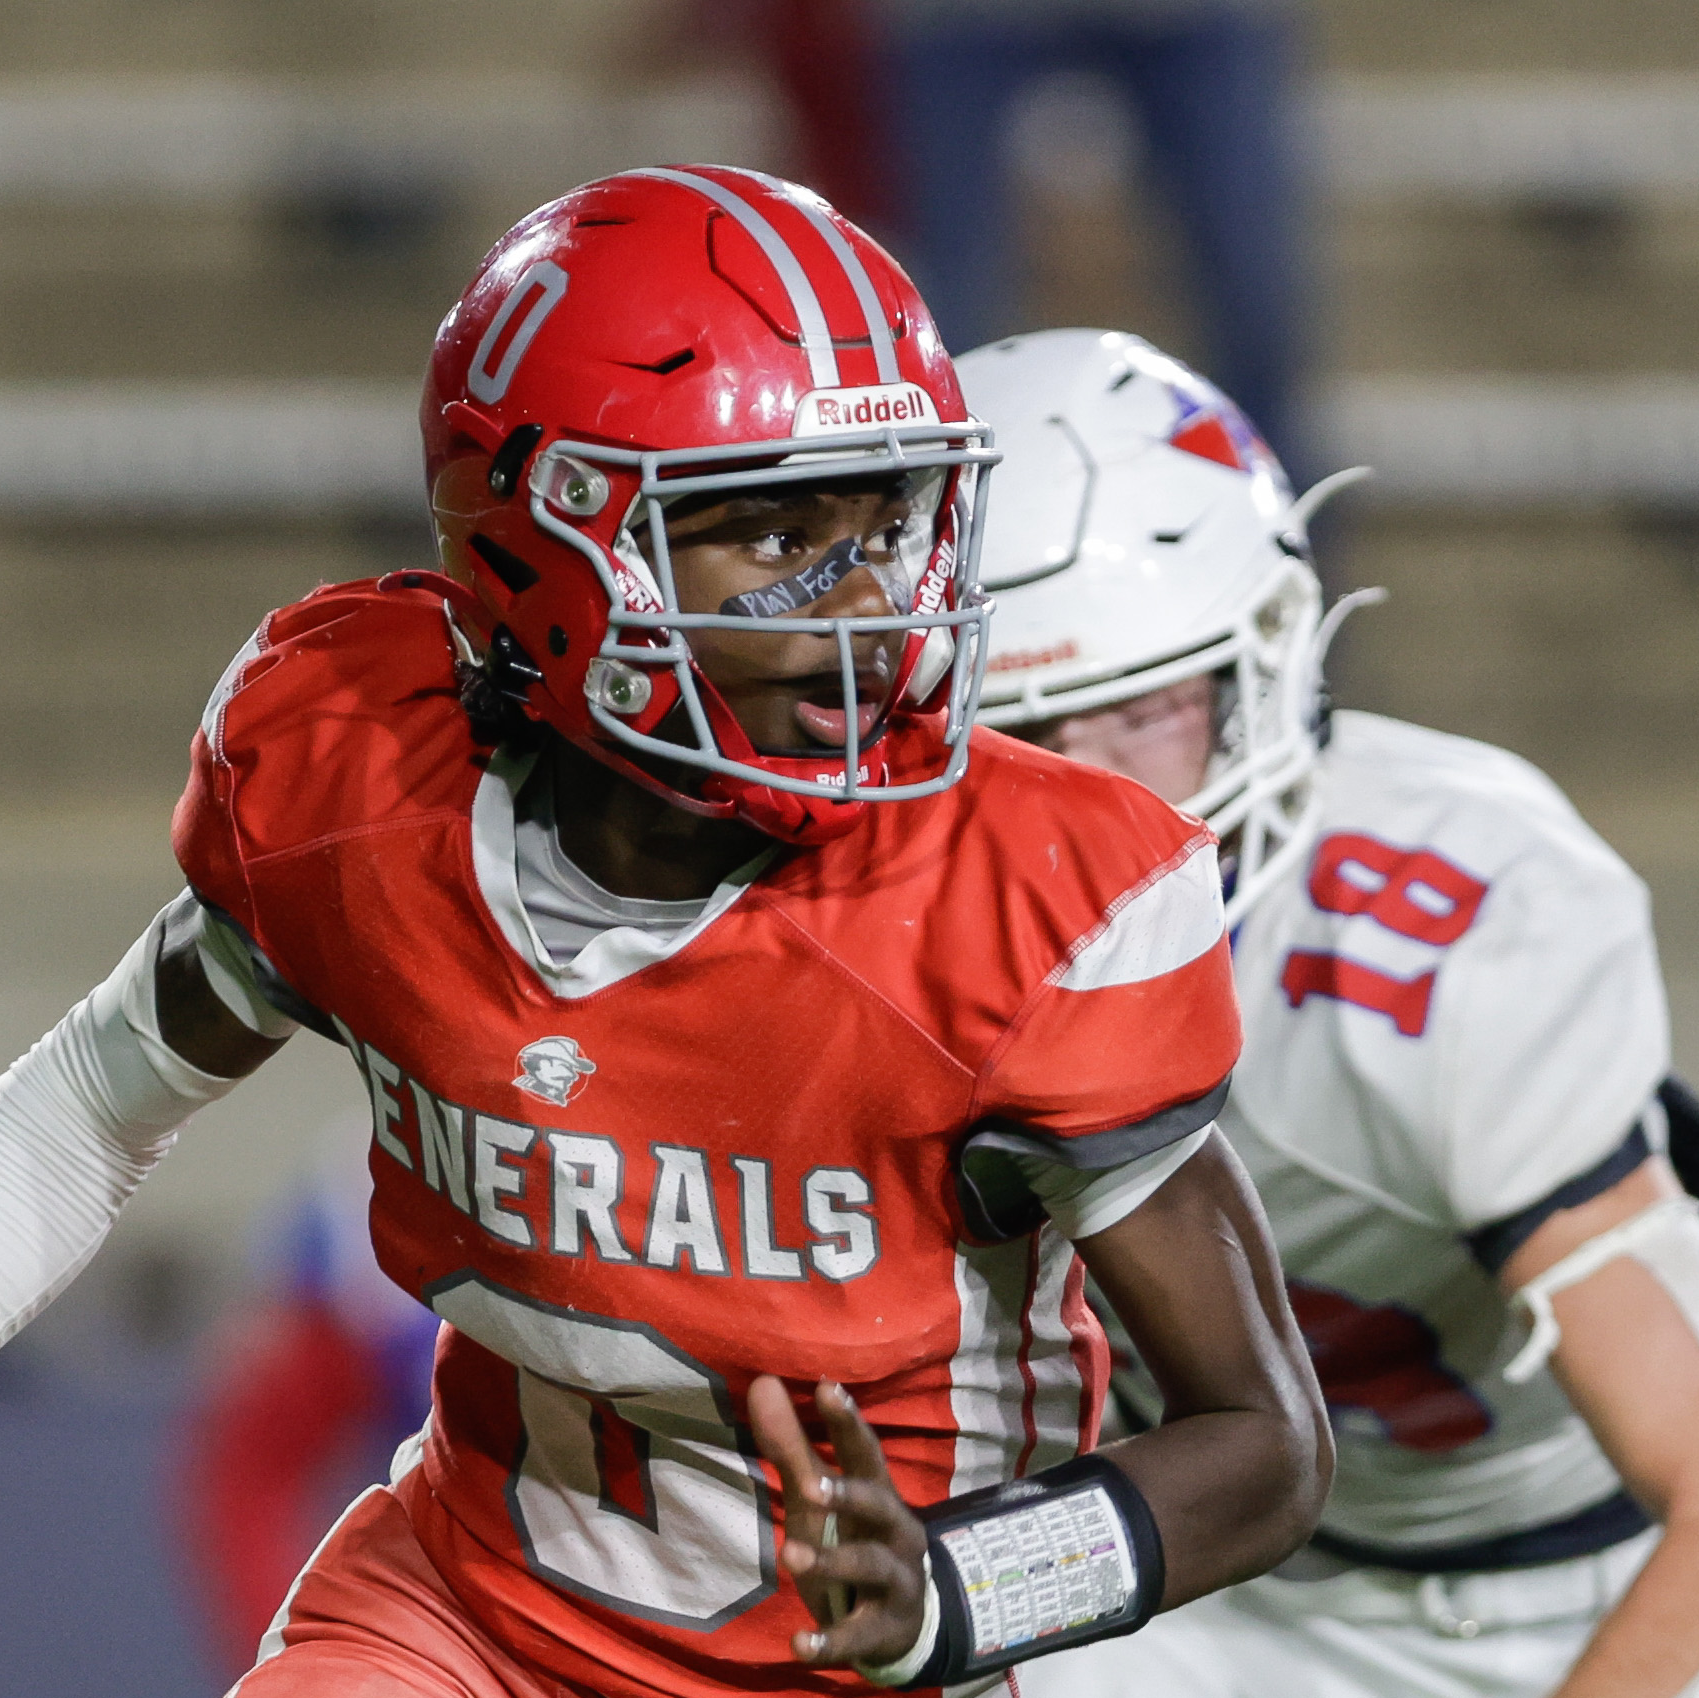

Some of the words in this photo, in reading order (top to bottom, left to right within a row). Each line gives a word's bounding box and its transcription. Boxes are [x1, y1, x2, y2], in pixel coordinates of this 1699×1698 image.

[467, 258, 570, 406] 0
[816, 390, 925, 425] Riddell
[738, 582, 796, 617] Play
[796, 560, 839, 599] For
[816, 765, 869, 787] Ridell
[1281, 832, 1489, 1038] 18
[331, 1012, 882, 1284] ENERALS
